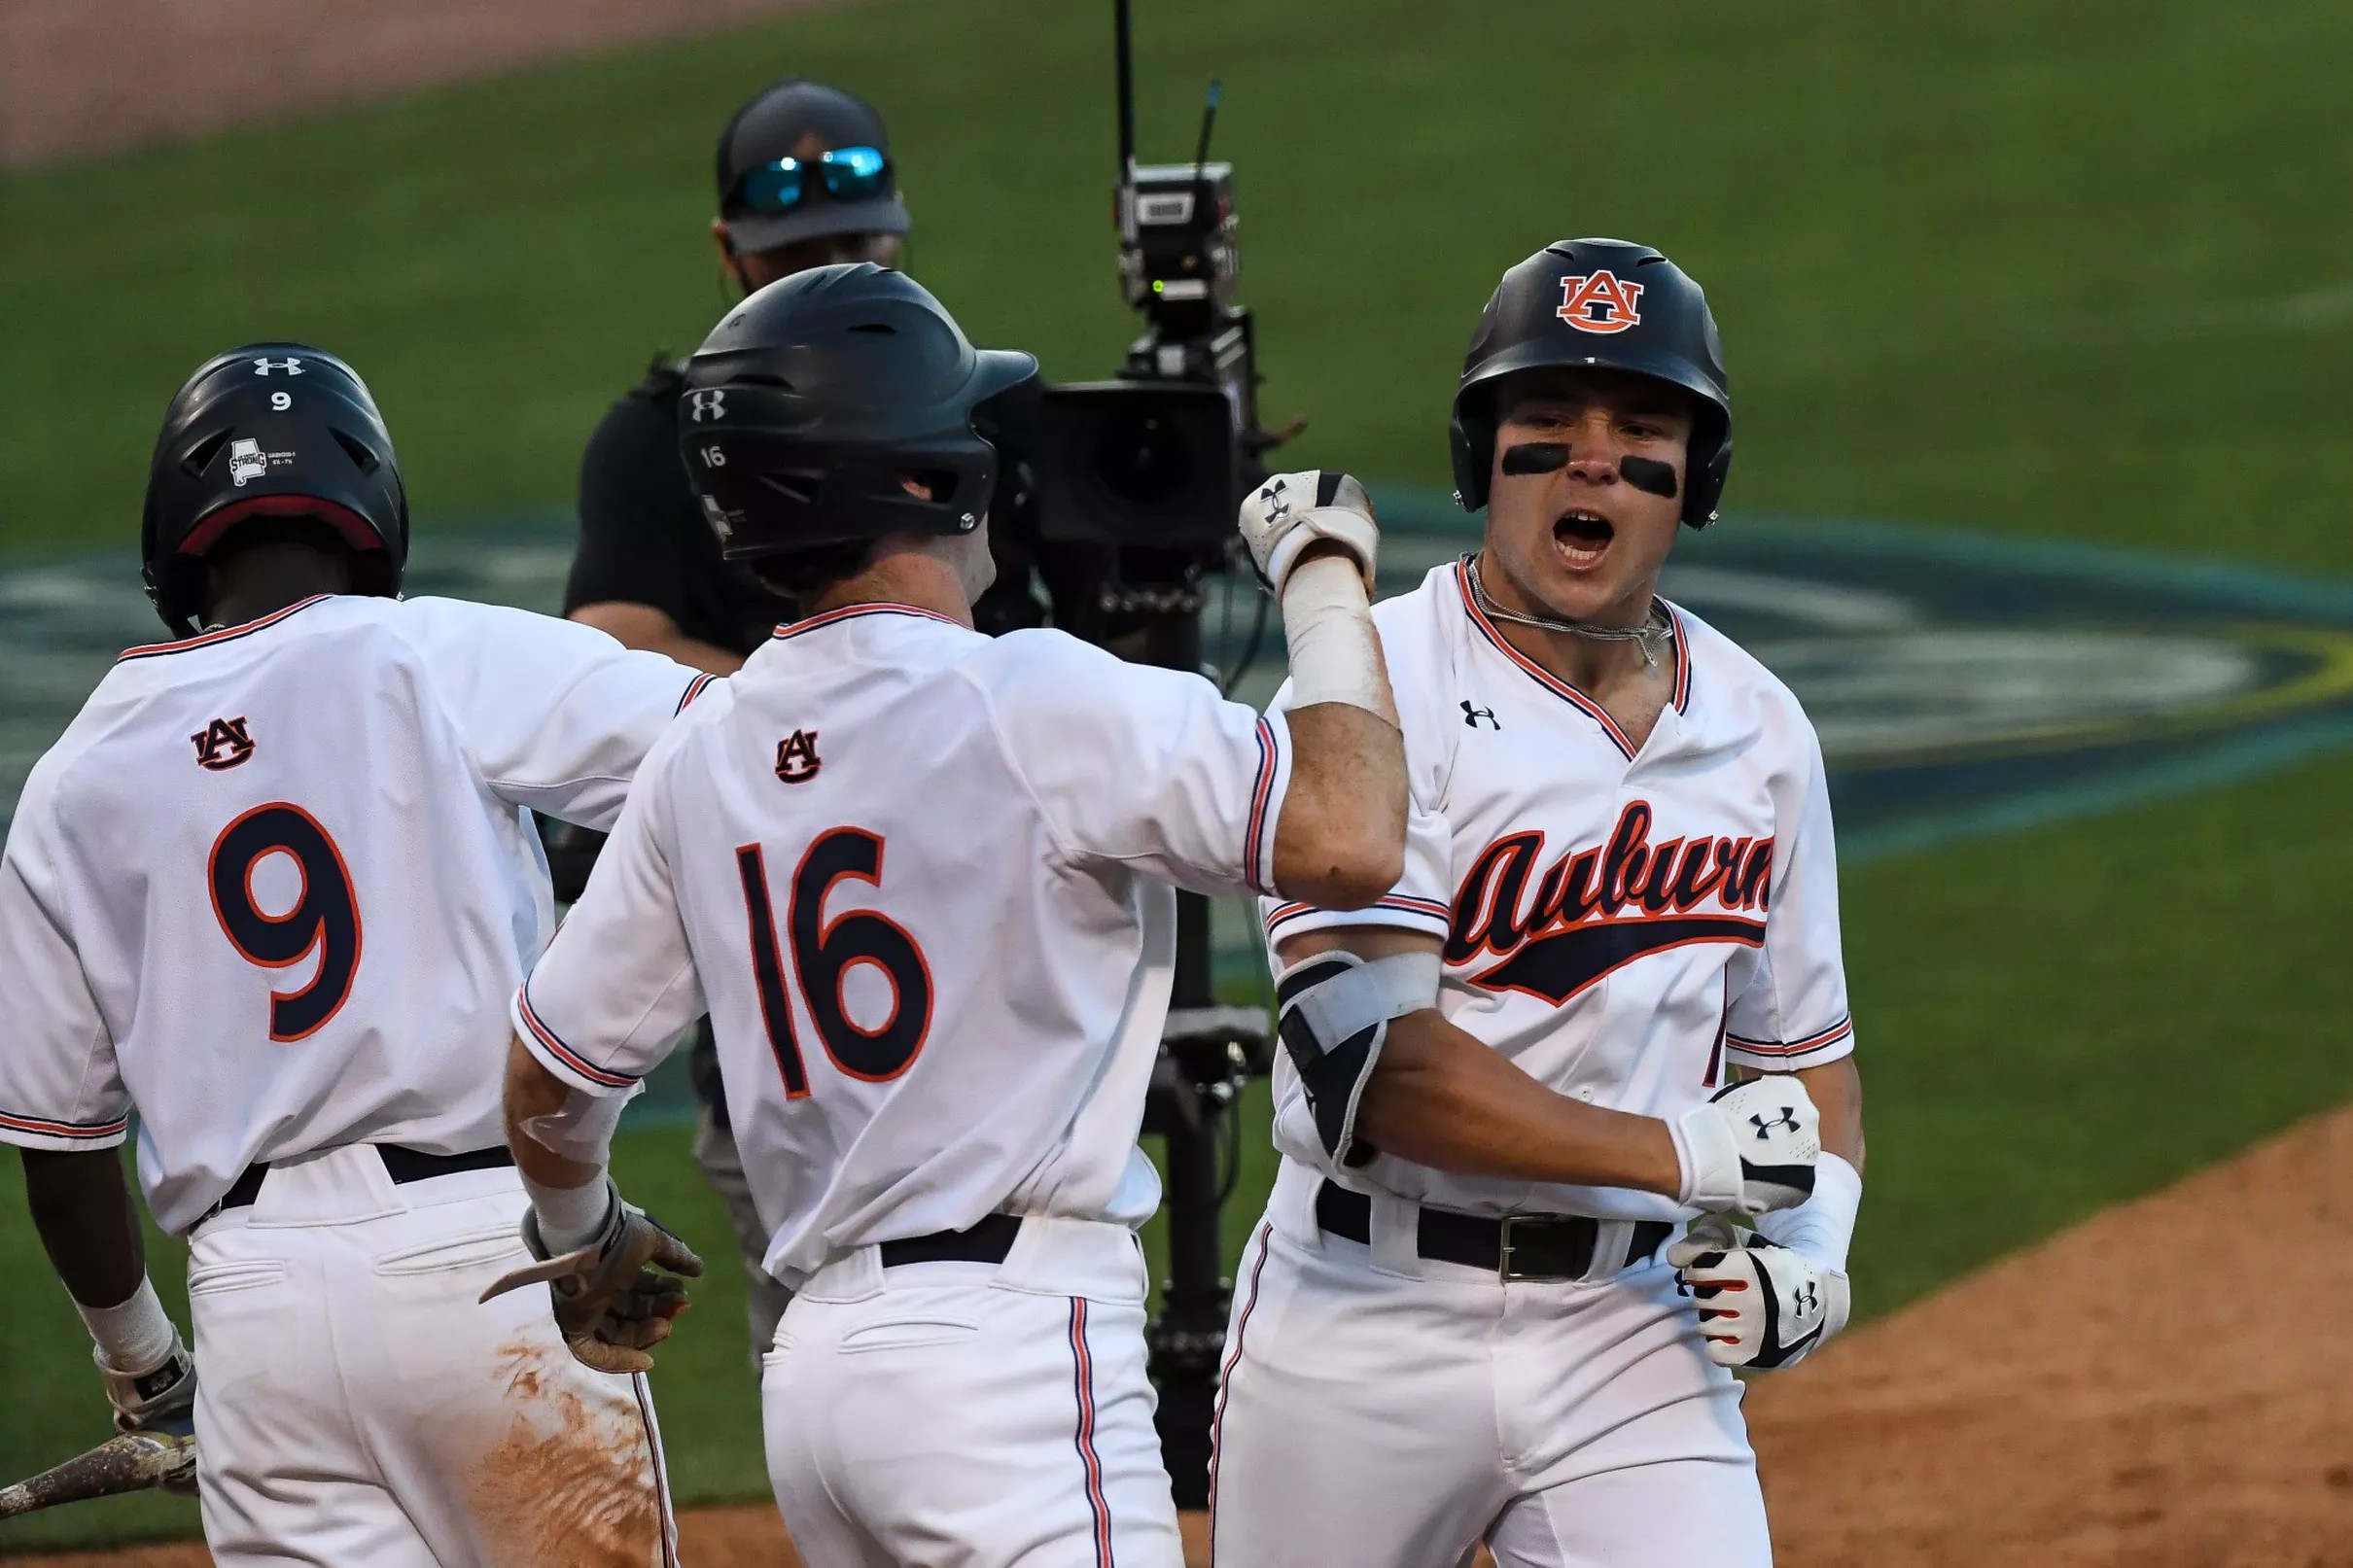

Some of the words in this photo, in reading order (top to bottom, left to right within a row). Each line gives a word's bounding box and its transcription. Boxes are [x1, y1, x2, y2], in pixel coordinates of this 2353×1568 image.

[271, 392, 292, 410] 9
[231, 453, 265, 471] STRONG
[700, 445, 726, 468] 16
[207, 801, 363, 1043] 9
[1443, 799, 1774, 966] Auburn
[735, 824, 934, 1099] 16
